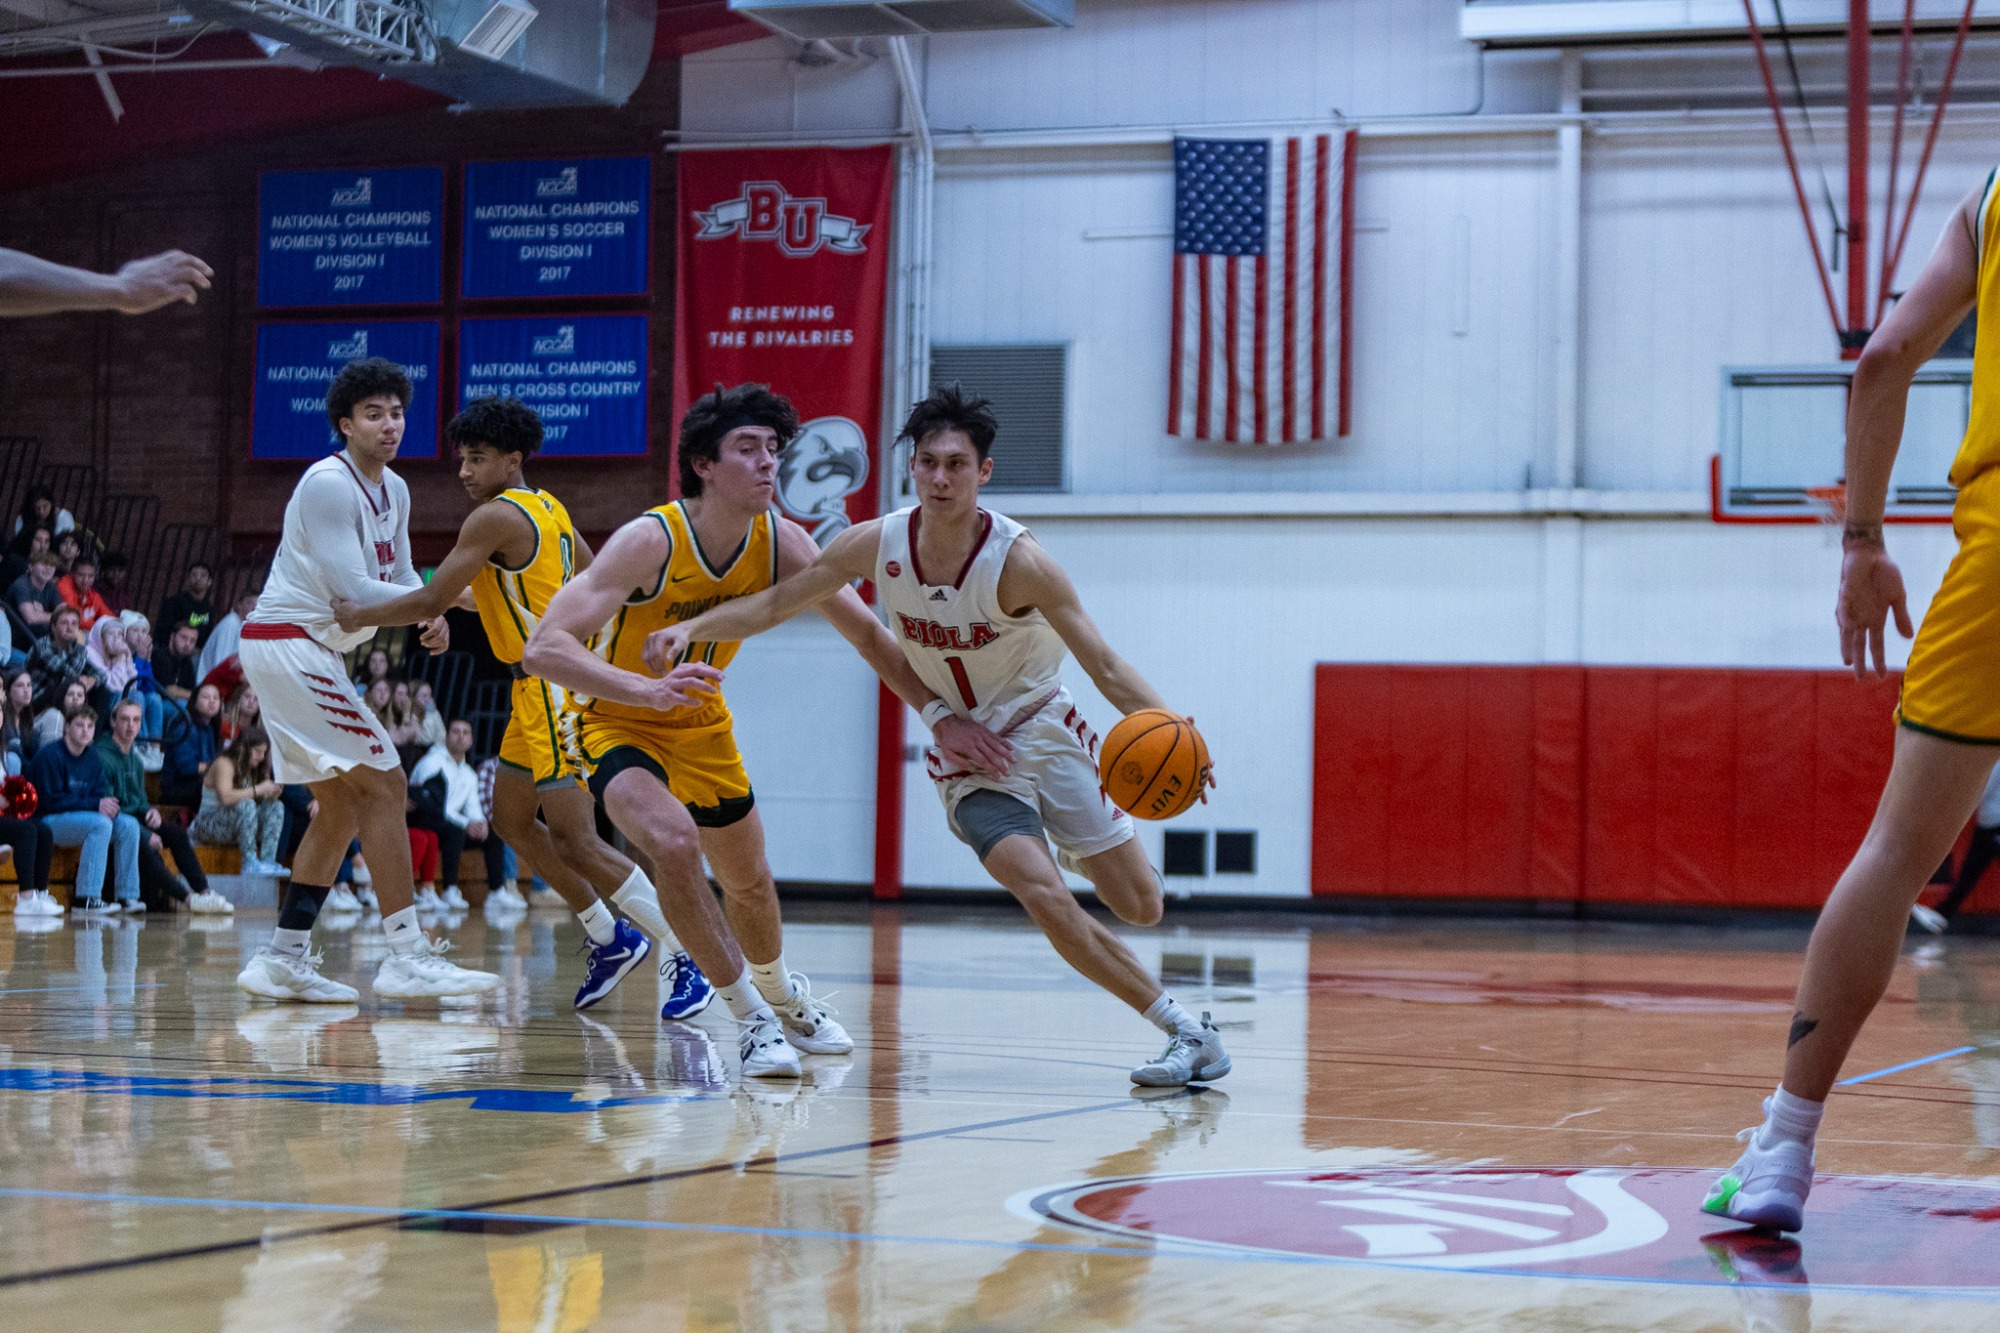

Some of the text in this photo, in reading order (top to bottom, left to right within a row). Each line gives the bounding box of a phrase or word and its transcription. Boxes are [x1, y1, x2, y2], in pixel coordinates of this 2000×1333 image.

[475, 201, 640, 219] NATIONAL CHAMPIONS
[271, 211, 432, 229] NATIONAL CHAMPIONS
[740, 181, 828, 258] BU
[489, 222, 625, 239] WOMEN'S SOCCER
[270, 231, 431, 250] WOMEN'S VOLLEYBALL
[520, 243, 593, 260] DIVISION I
[315, 253, 385, 270] DIVISION I
[334, 275, 365, 290] 2017
[539, 266, 571, 282] 2017
[729, 305, 835, 322] RENEWING
[708, 329, 854, 347] THE RIVALRIES
[267, 366, 336, 381] NATIONAL
[471, 360, 637, 377] NATIONAL CHAMPIONS
[515, 383, 566, 397] CROSS
[570, 381, 641, 397] COUNTRY
[529, 402, 589, 418] VISION I
[543, 425, 569, 439] 017
[896, 611, 1000, 650] BIOLA
[944, 656, 978, 710] 1
[1151, 774, 1182, 812] EVO
